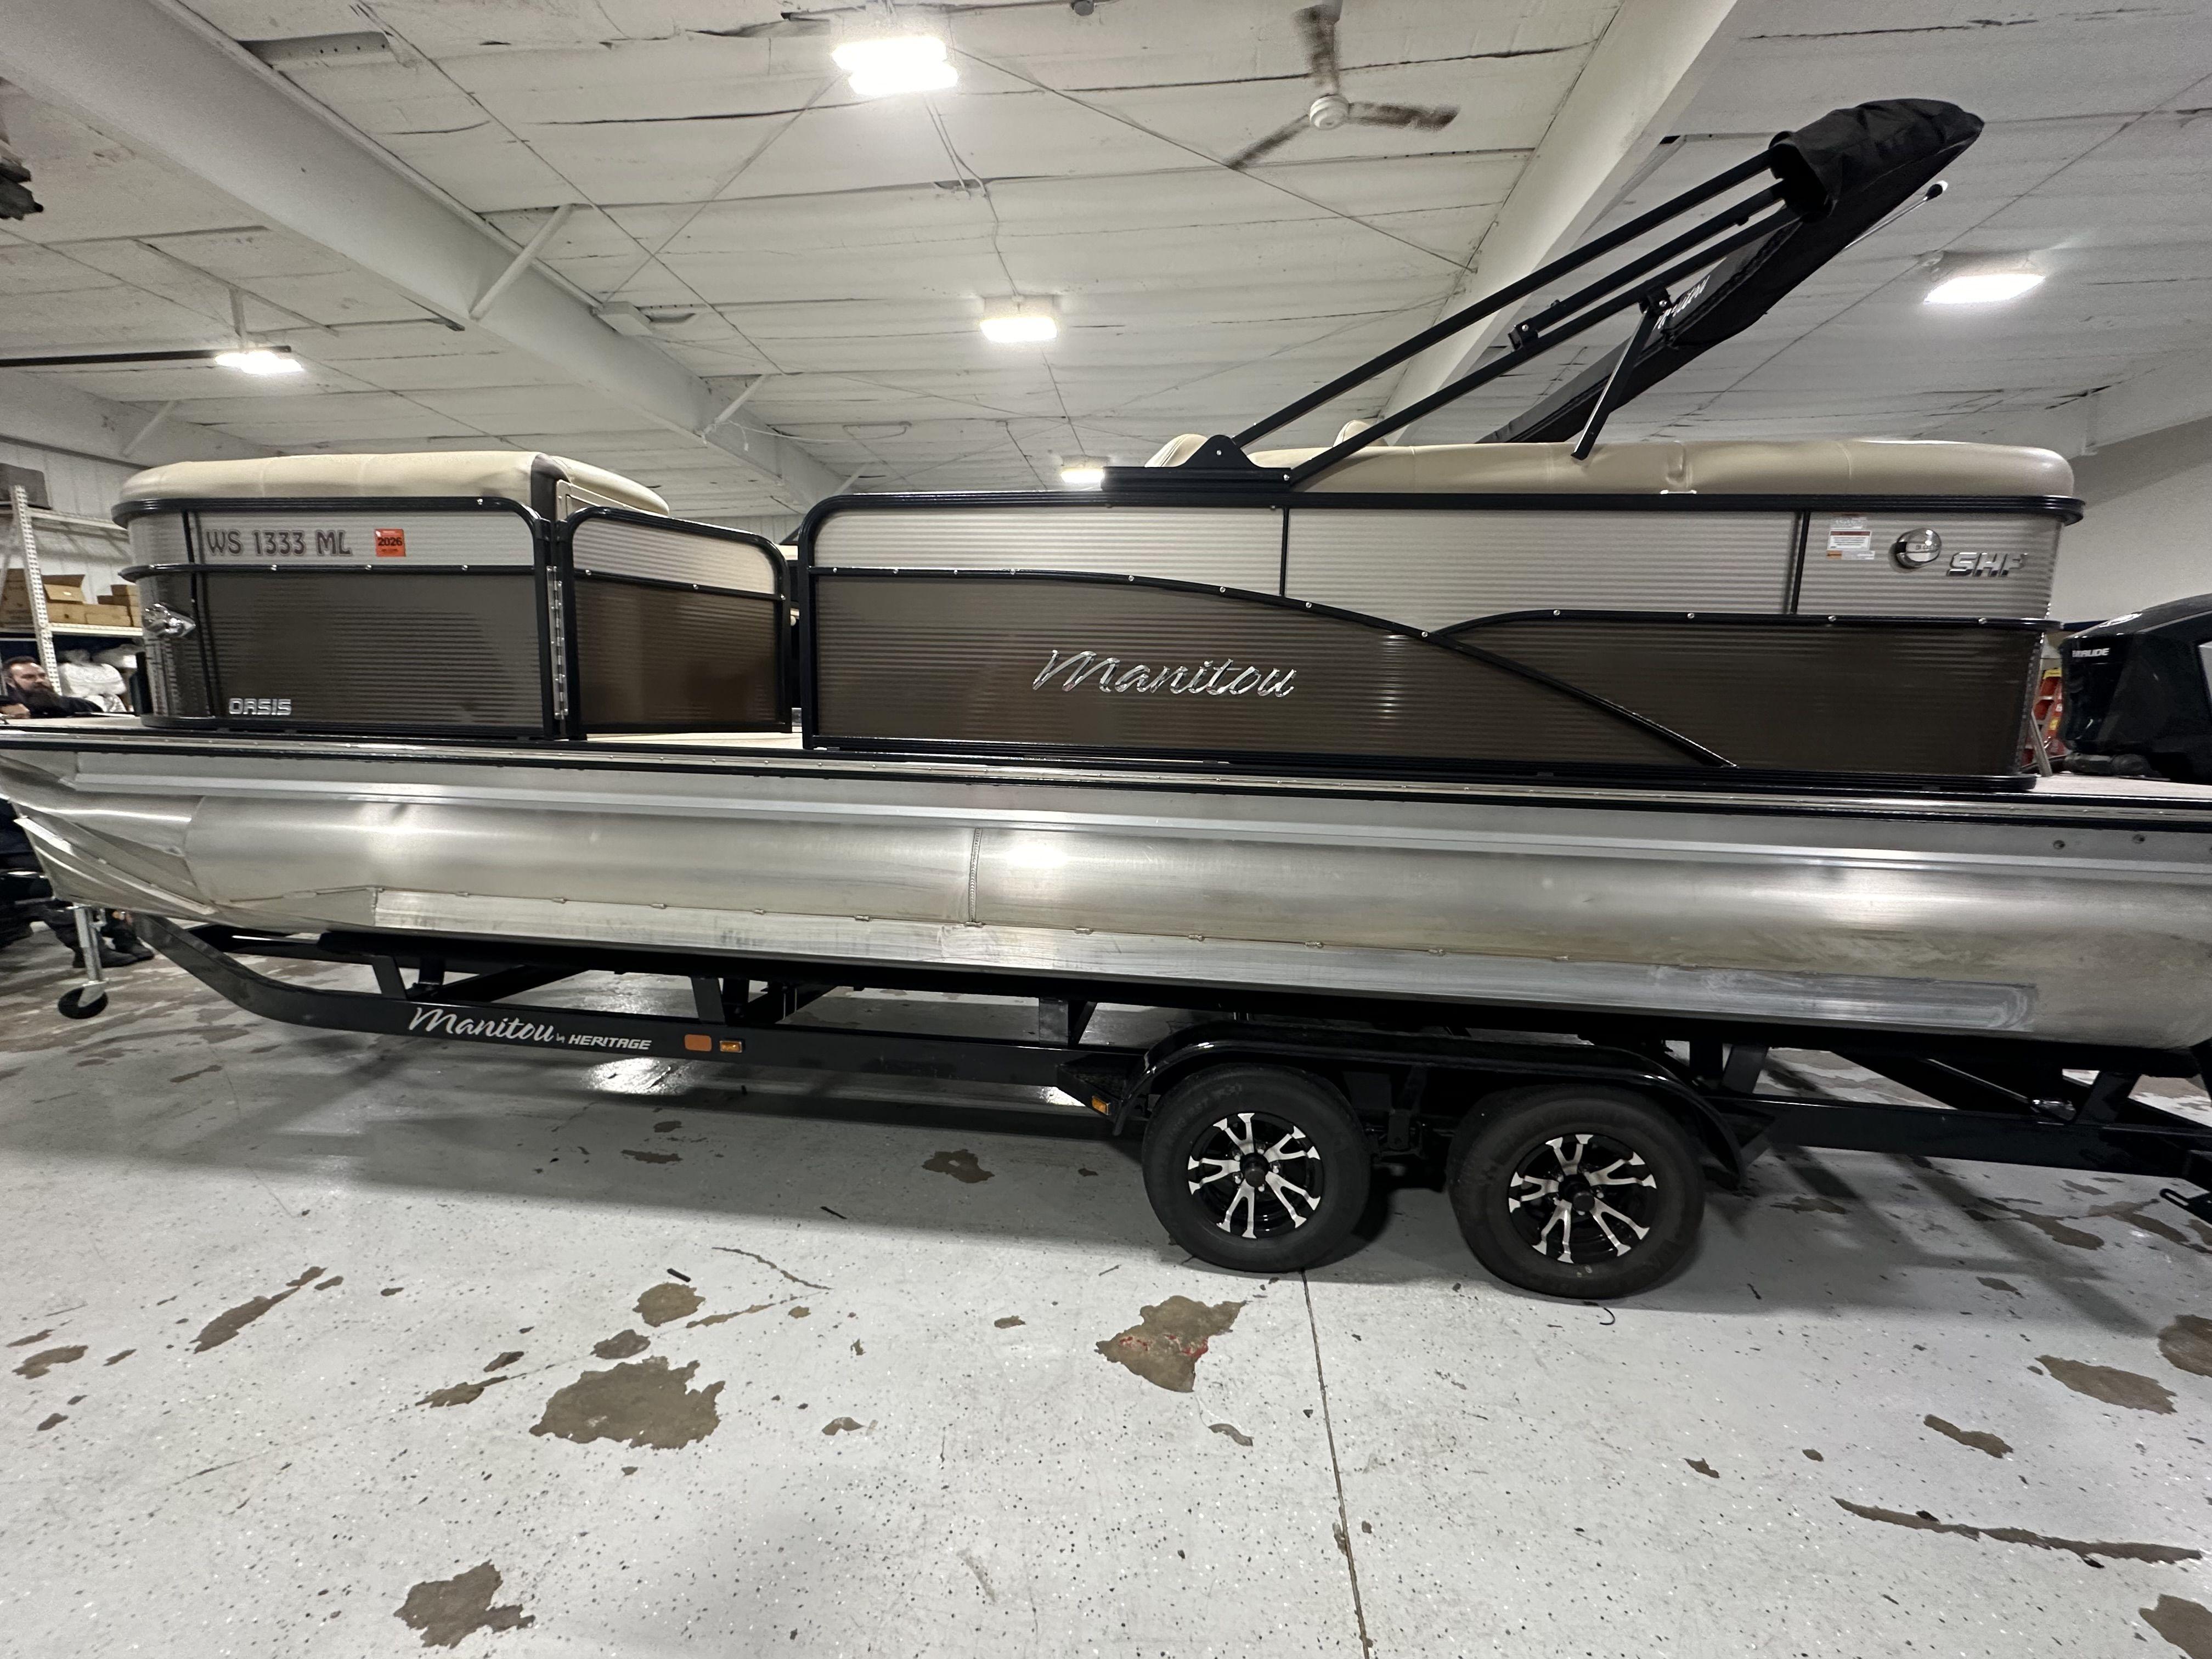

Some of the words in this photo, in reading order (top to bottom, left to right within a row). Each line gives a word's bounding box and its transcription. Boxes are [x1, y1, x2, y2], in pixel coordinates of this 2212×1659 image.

[205, 529, 243, 556] WS
[252, 530, 306, 556] 1333
[315, 529, 352, 556] ML
[377, 537, 403, 546] 2026
[1032, 650, 1297, 698] Manitou
[229, 698, 292, 715] OASIS
[408, 1007, 554, 1042] Manitou
[568, 1034, 652, 1050] HERITAGE
